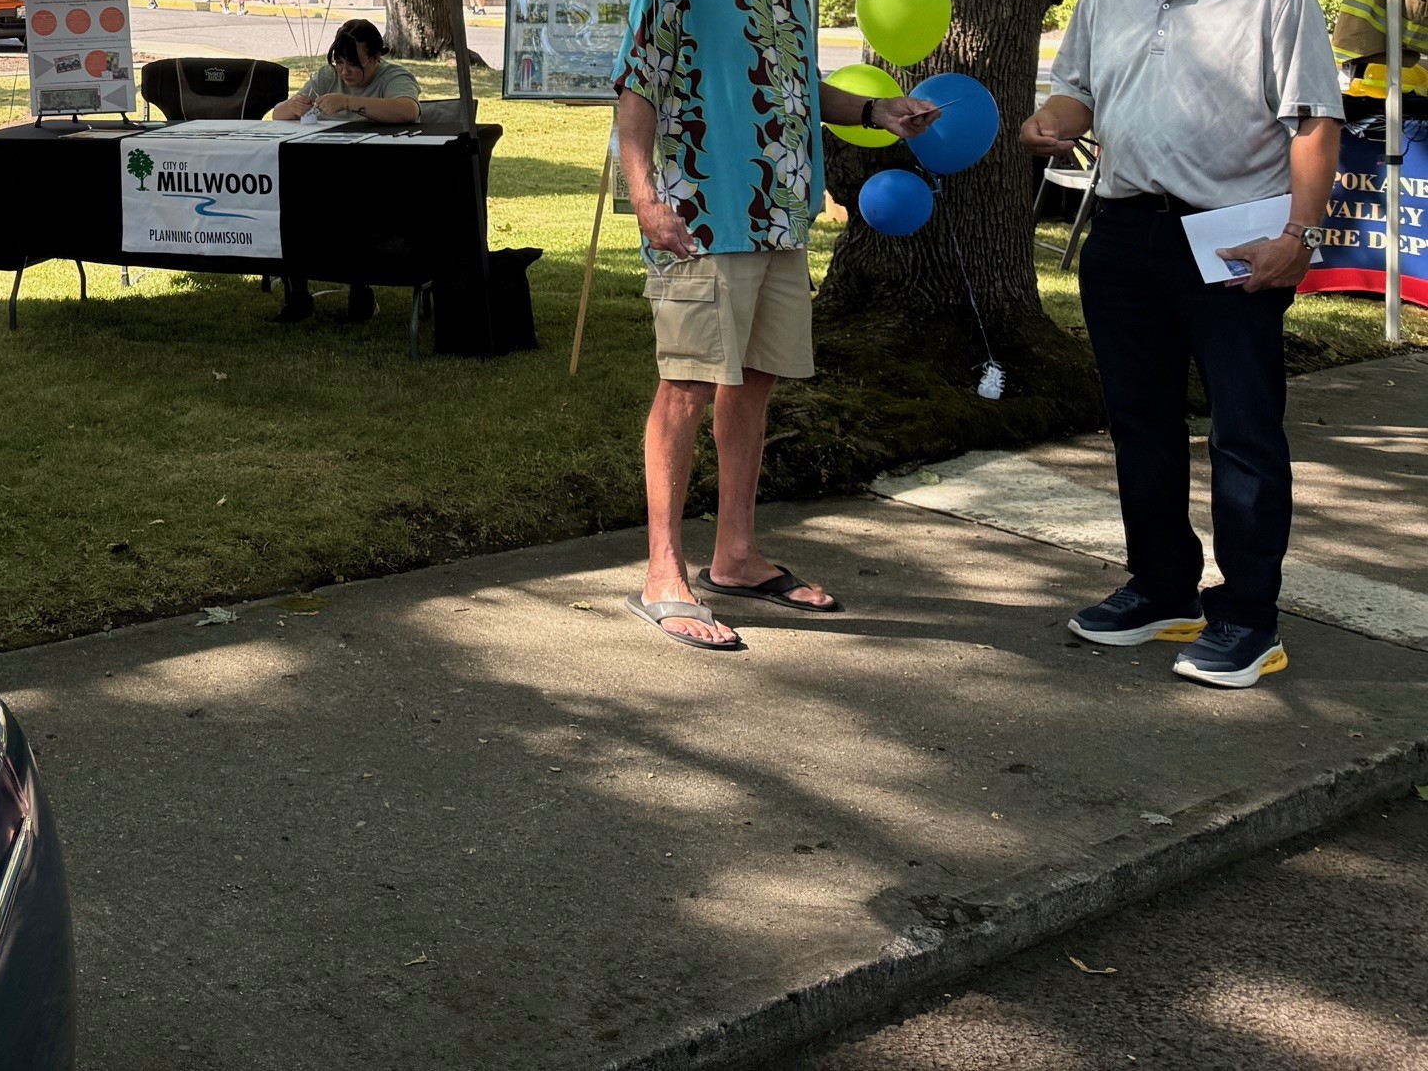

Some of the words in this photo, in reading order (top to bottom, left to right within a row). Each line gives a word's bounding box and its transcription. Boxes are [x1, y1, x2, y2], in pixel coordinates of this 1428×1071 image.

[162, 161, 177, 171] CITY
[179, 161, 188, 171] OF
[157, 171, 273, 195] MILLWOOD
[1332, 171, 1428, 198] POKNE
[149, 229, 192, 244] PLANNING
[194, 230, 253, 245] COMMISSION
